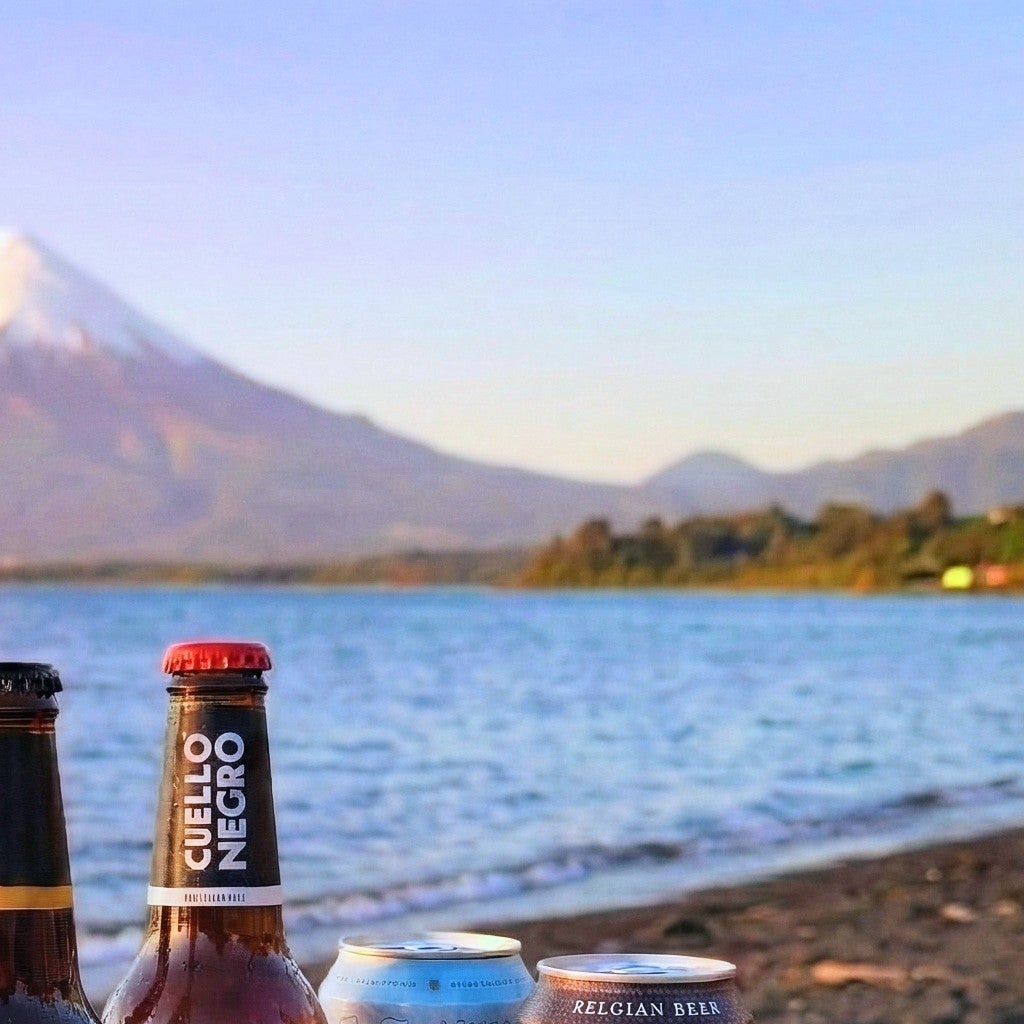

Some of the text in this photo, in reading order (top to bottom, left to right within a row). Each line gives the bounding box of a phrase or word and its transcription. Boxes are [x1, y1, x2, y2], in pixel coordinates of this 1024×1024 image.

[183, 733, 213, 871] CUELLO
[214, 732, 247, 870] NEGRO
[674, 1001, 721, 1016] BEER
